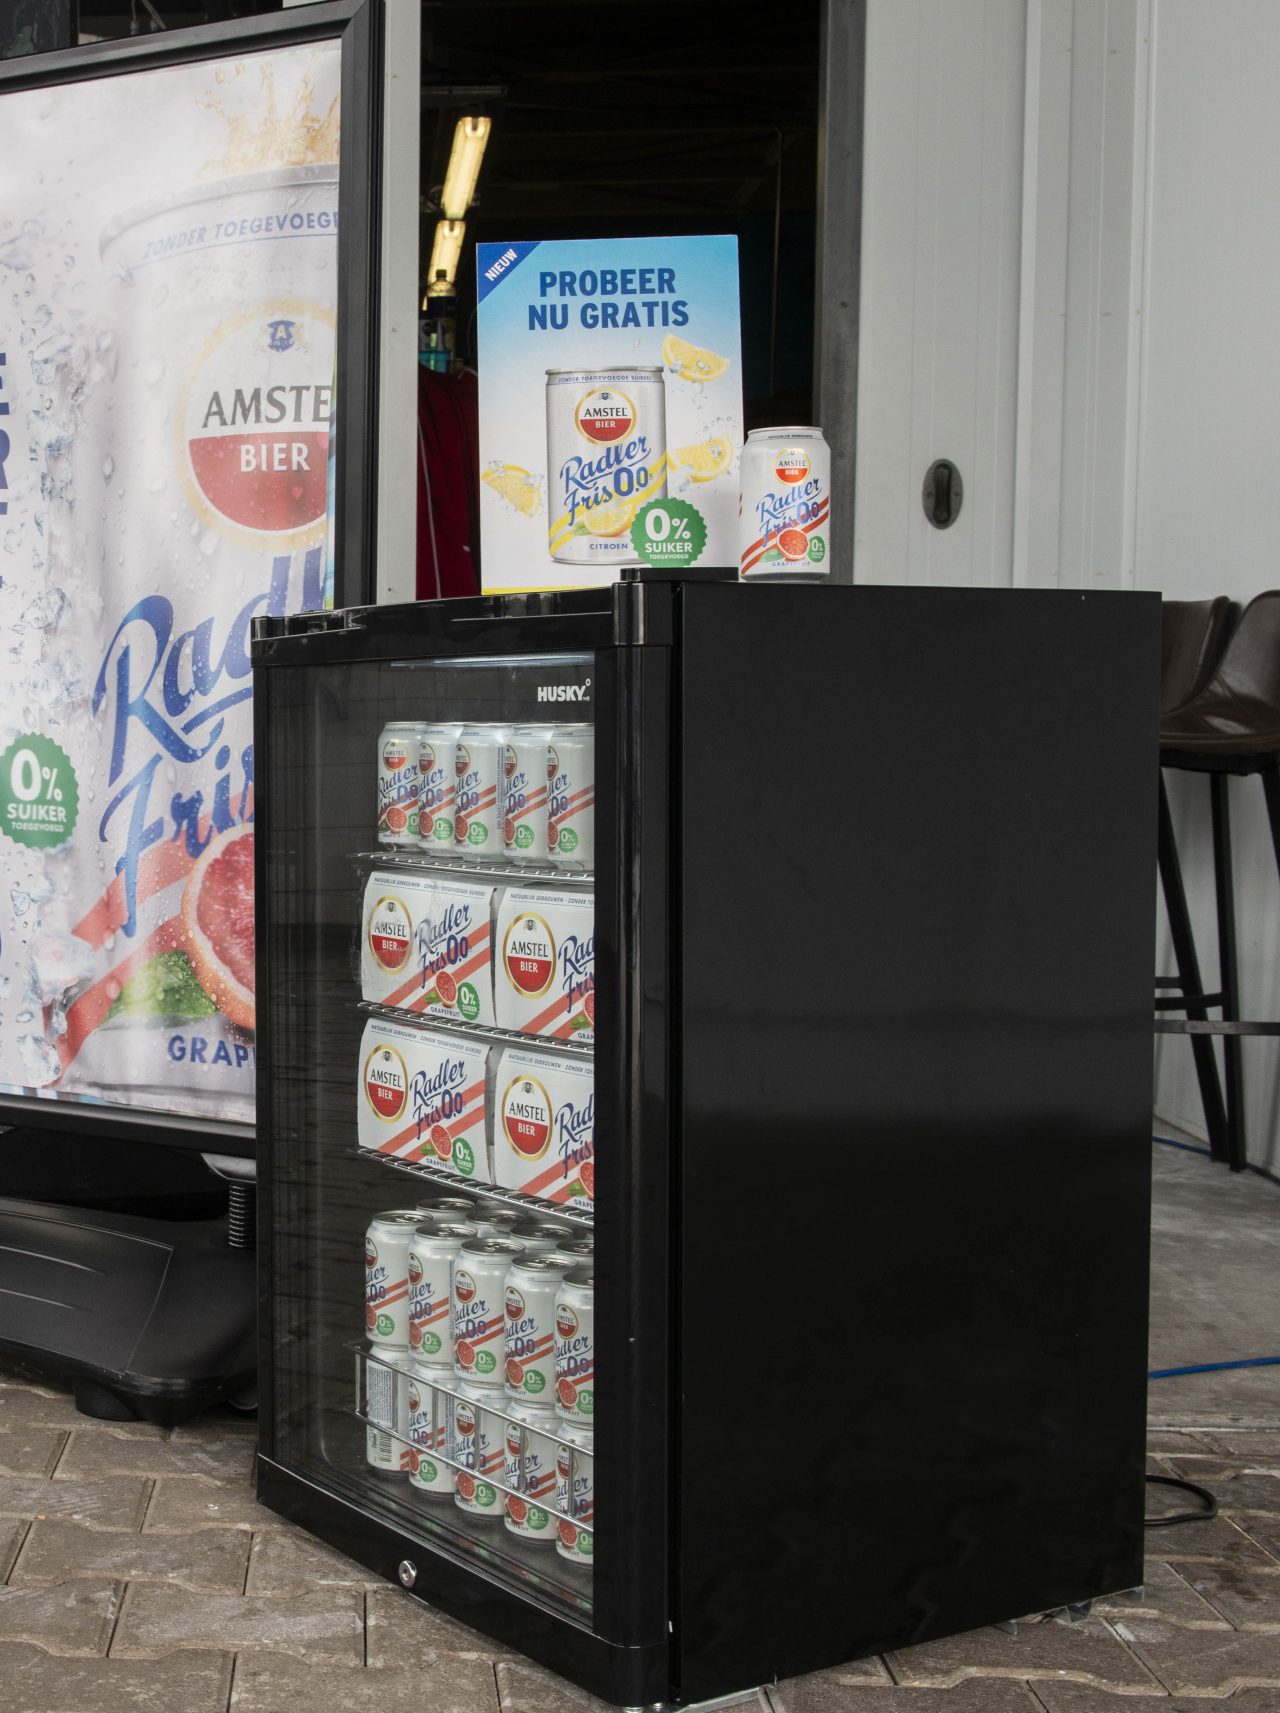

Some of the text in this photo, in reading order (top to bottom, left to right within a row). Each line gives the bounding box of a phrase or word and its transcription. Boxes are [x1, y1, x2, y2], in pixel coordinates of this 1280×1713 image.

[143, 226, 208, 259] ZONDER
[484, 249, 518, 281] NIEUW
[540, 268, 676, 297] PROBEER
[528, 300, 690, 331] NU GRATIS
[583, 407, 627, 418] AMSTEL
[239, 443, 311, 474] BIER
[560, 436, 651, 494] Radler
[756, 477, 821, 523] Radler
[645, 508, 691, 541] 0%
[645, 542, 693, 553] SUIKER
[11, 748, 63, 802] 0%
[6, 803, 67, 822] SUIKER
[11, 821, 64, 832] TOEGEVOEGD
[374, 921, 407, 937] AMSTEL
[414, 904, 472, 956] Radler
[382, 939, 398, 950] BIER
[510, 940, 548, 958] AMSTEL
[520, 961, 538, 973] BIER
[430, 1006, 460, 1017] GRAPEFRUIT
[168, 1035, 255, 1068] GRAP
[370, 1069, 402, 1088] AMSTEL
[410, 1058, 467, 1108] Radler
[377, 1088, 393, 1100] BIER
[509, 1101, 545, 1122] AMSTEL
[518, 1123, 535, 1136] BIER
